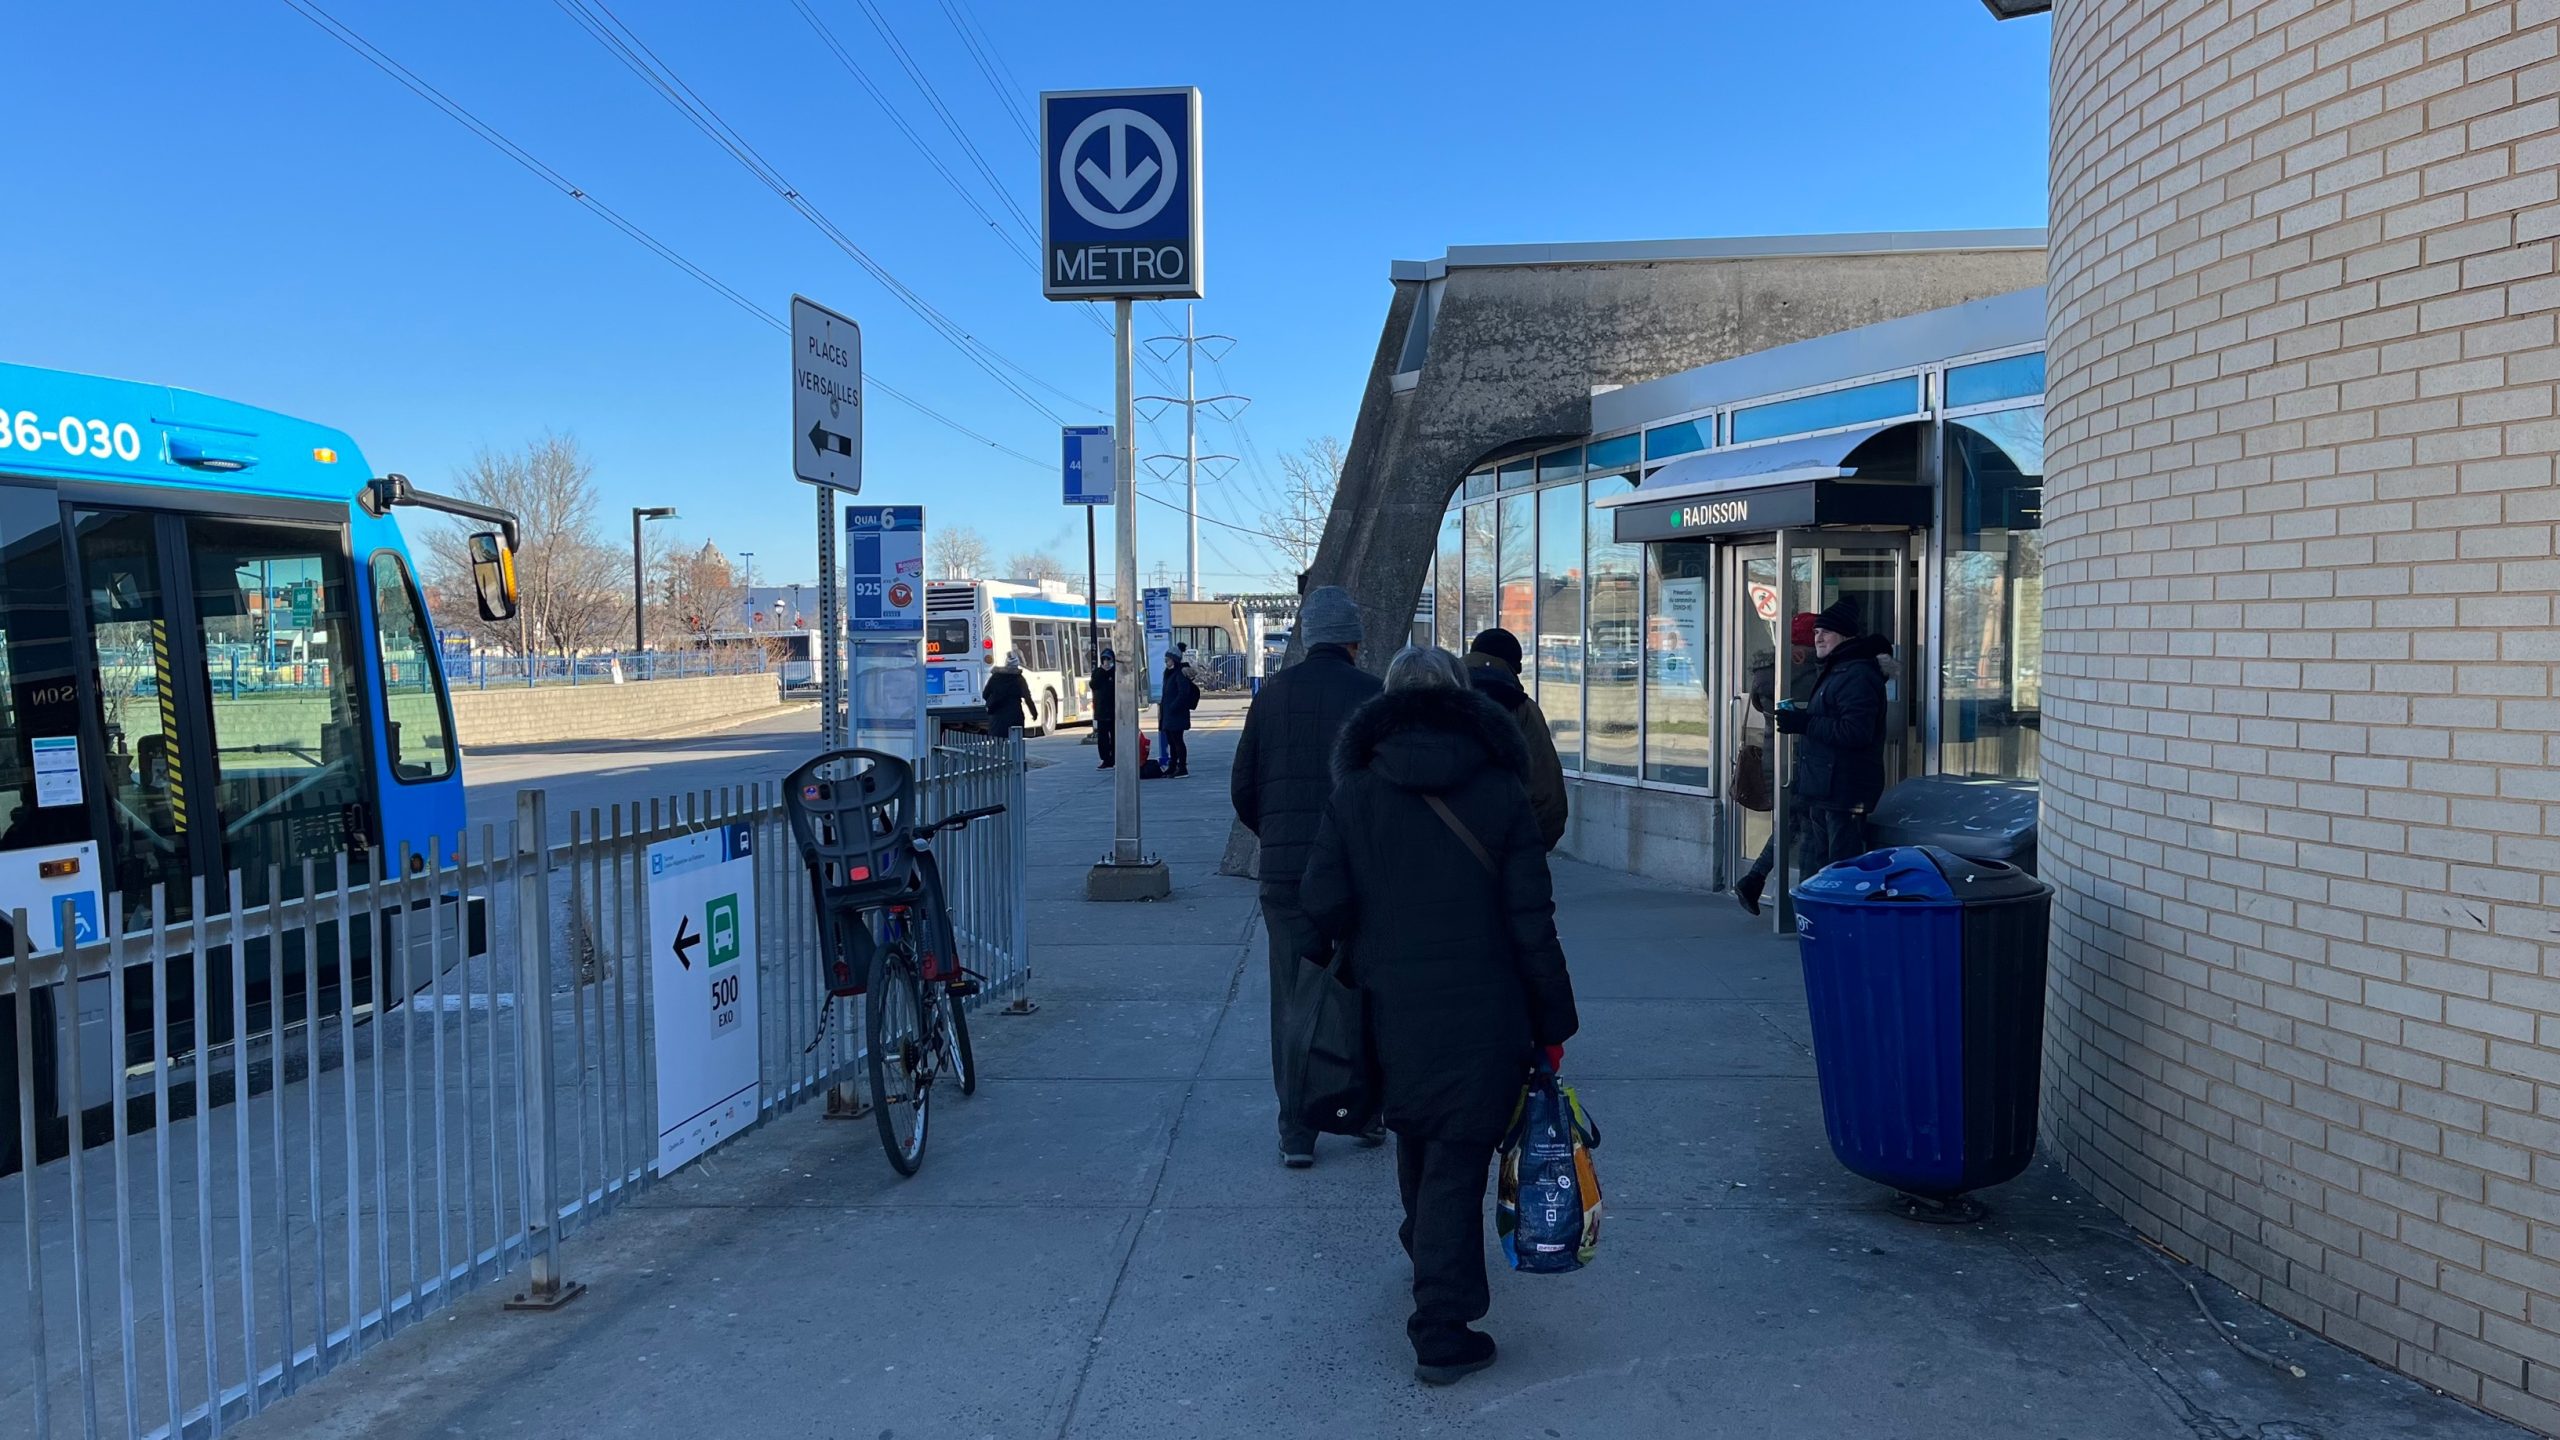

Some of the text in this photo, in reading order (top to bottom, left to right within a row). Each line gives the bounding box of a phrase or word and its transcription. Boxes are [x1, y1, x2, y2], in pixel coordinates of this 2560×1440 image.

[1056, 244, 1184, 281] MÉTRO
[808, 335, 848, 368] PLACES
[798, 368, 859, 408] VERSAILLES
[854, 507, 895, 530] QUAI 6
[1683, 500, 1748, 528] RADISSON
[856, 582, 881, 596] 925
[712, 974, 739, 1011] 500
[719, 1010, 733, 1027] EXO
